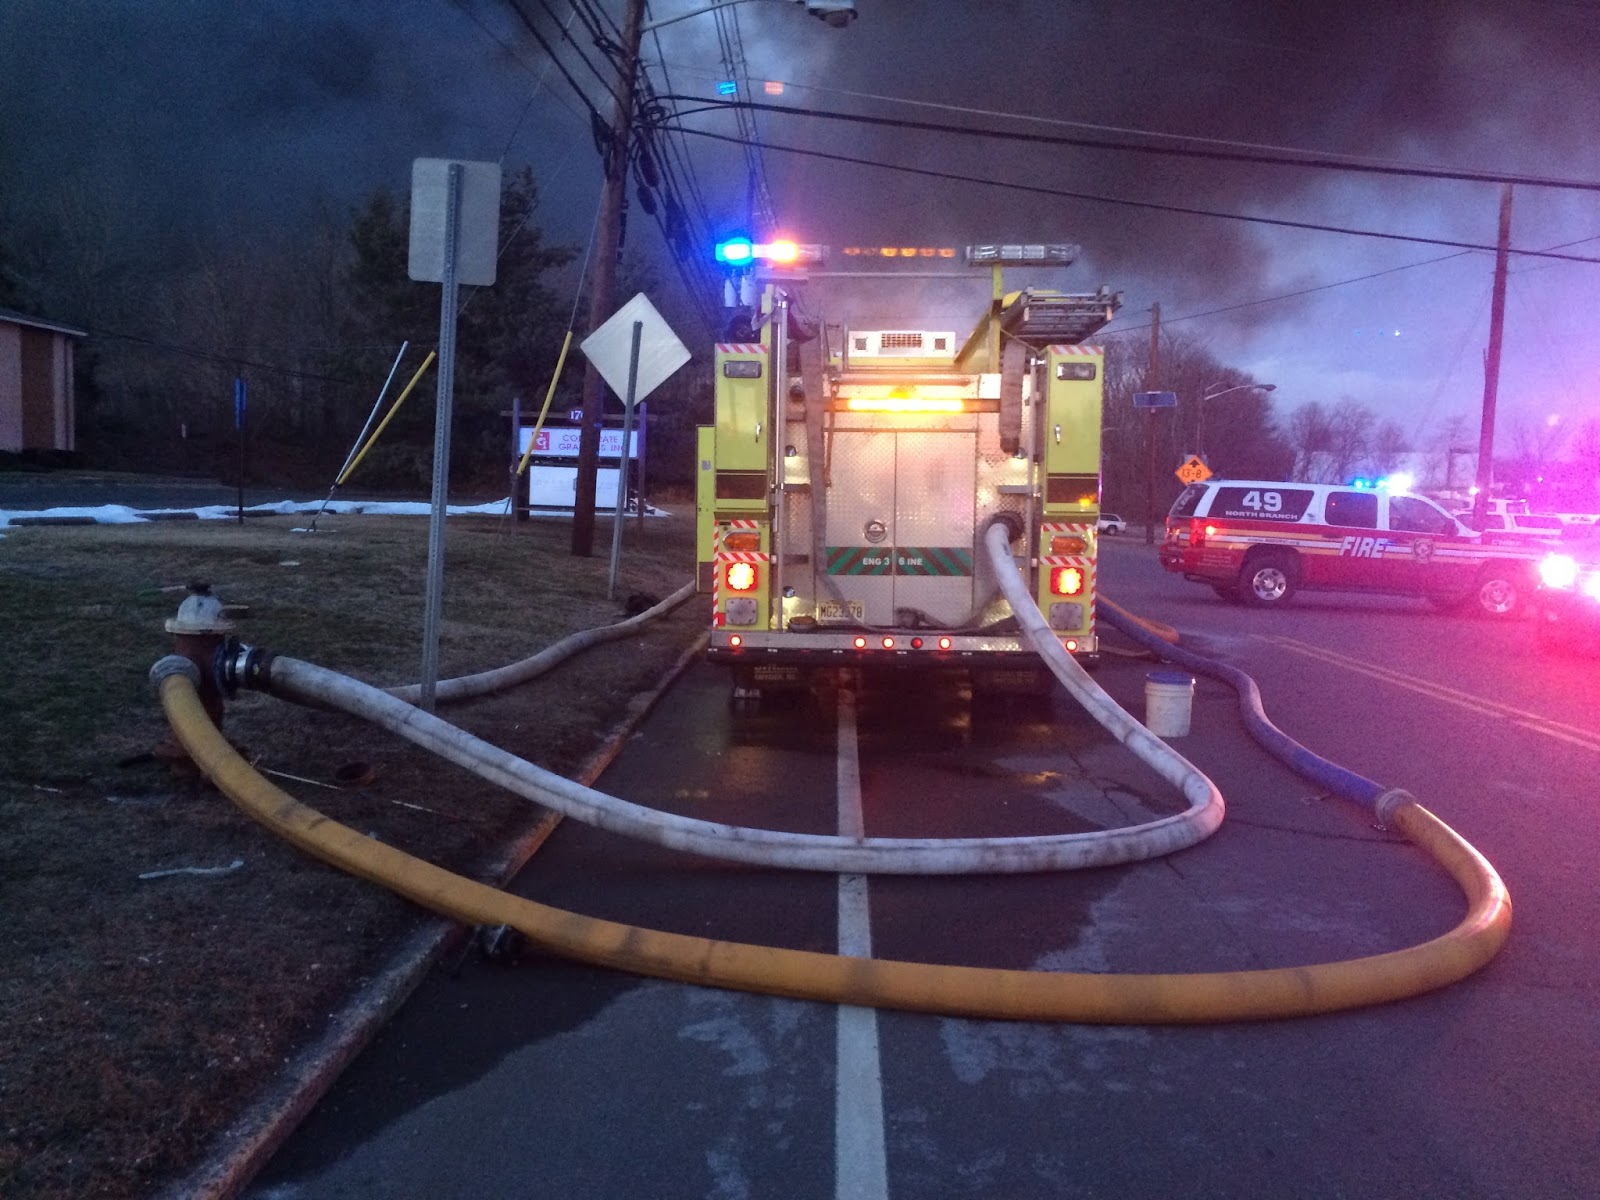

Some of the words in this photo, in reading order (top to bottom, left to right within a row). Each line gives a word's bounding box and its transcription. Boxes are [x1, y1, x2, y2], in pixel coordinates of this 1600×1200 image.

[563, 434, 618, 443] COATE
[1242, 490, 1283, 512] 49
[1225, 510, 1258, 519] NORTH
[1259, 511, 1298, 521] BRANCH
[1338, 536, 1389, 560] FIRE
[862, 557, 882, 566] ENG
[907, 557, 923, 566] INE
